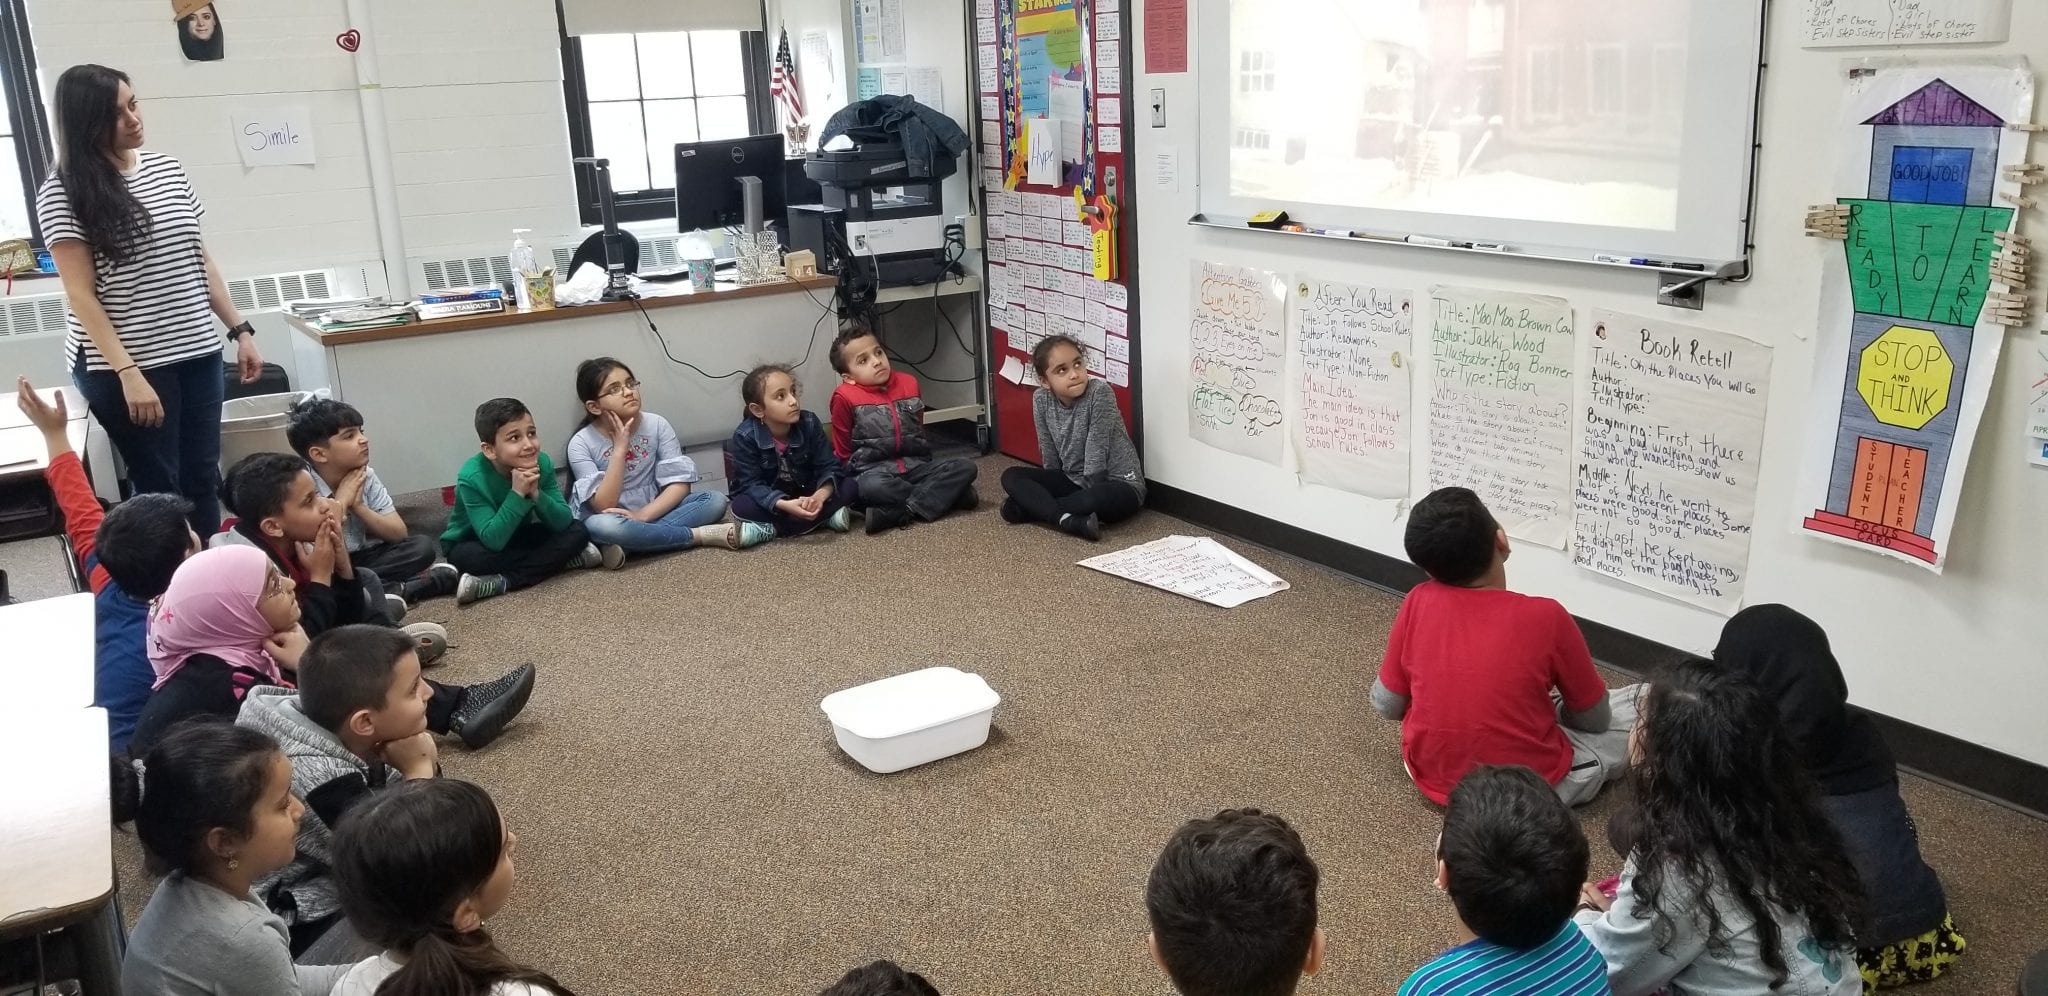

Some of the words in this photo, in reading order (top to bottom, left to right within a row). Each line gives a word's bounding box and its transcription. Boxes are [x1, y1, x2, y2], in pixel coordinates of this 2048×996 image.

[1812, 28, 1834, 40] Evil
[1894, 30, 1913, 39] Evil
[244, 121, 299, 151] Simile
[1032, 133, 1055, 173] Hype
[1894, 164, 1930, 181] GOOD
[1931, 165, 1965, 182] JOB!
[1850, 204, 1888, 312] READY
[1913, 225, 1933, 281] TO
[1950, 211, 1994, 325] LEARN
[1314, 283, 1346, 305] After
[1347, 287, 1369, 310] You
[1369, 288, 1394, 314] Read
[1432, 297, 1470, 323] Title:
[1472, 303, 1491, 325] Moo
[1493, 304, 1514, 328] Moo
[1518, 308, 1552, 333] Brown
[1299, 308, 1320, 326] Title:
[1371, 319, 1393, 333] School
[1300, 324, 1329, 340] Author:
[1432, 320, 1467, 343] Author:
[1469, 327, 1504, 349] Jakki
[1513, 331, 1545, 353] Wood
[1298, 339, 1346, 359] Illustrator:
[1432, 340, 1496, 366] Illustrator:
[1530, 355, 1573, 378] Bonner
[1640, 328, 1682, 361] Book
[1690, 338, 1733, 370] Retell
[1874, 340, 1942, 373] STOP
[1302, 372, 1325, 393] Main
[1326, 378, 1357, 399] Idea:
[1458, 363, 1492, 388] Type:
[1496, 370, 1538, 397] Fiction
[1592, 346, 1627, 369] Title:
[1630, 358, 1646, 375] Oh,
[1648, 363, 1666, 378] the
[1668, 365, 1701, 385] Places
[1704, 373, 1724, 390] You
[1745, 383, 1756, 395] Go
[1592, 367, 1628, 386] Author:
[1891, 374, 1910, 383] AND
[1300, 391, 1317, 408] The
[1323, 400, 1342, 412] main
[1346, 402, 1363, 415] idea
[1368, 407, 1375, 419] is
[1380, 405, 1400, 423] that
[1591, 392, 1613, 407] Text
[1618, 399, 1645, 415] Type:
[1592, 382, 1650, 402] Illustrator:
[1868, 378, 1939, 416] THINK
[1322, 414, 1329, 422] is
[1335, 415, 1353, 427] good
[1357, 419, 1365, 431] in
[1371, 421, 1395, 435] class
[1468, 416, 1477, 425] the
[1587, 406, 1652, 438] Beginning:
[1657, 426, 1693, 452] First,
[1699, 434, 1744, 461] there
[1582, 449, 1598, 460] the
[1607, 456, 1643, 469] world.
[1585, 426, 1607, 439] was
[1615, 434, 1623, 442] a
[1652, 442, 1694, 469] walking
[1699, 456, 1720, 469] and
[1578, 463, 1617, 484] Middle:
[1659, 481, 1673, 502] he
[1680, 498, 1712, 513] went
[1715, 507, 1730, 521] to
[1694, 466, 1721, 480] show
[1725, 475, 1736, 486] us
[1861, 441, 1877, 515] STUDENT
[1896, 448, 1912, 528] TEACHER
[1574, 501, 1597, 514] were
[1602, 507, 1619, 518] not
[1650, 523, 1686, 539] good.
[1579, 479, 1583, 488] a
[1608, 485, 1619, 498] of
[1627, 493, 1680, 515] different
[1722, 519, 1750, 534] Some
[1603, 498, 1627, 509] were
[1632, 506, 1663, 521] good.
[1694, 522, 1725, 539] places
[1853, 520, 1899, 539] FOCUS
[1857, 530, 1891, 548] CARD
[1575, 513, 1602, 536] End:
[1644, 537, 1662, 556] he
[1697, 560, 1739, 583] going,
[1576, 531, 1587, 542] he
[1640, 551, 1658, 566] the
[1663, 556, 1683, 572] bad
[1686, 569, 1718, 584] places
[1574, 541, 1596, 555] stop
[1606, 549, 1622, 564] him
[1631, 559, 1656, 576] from
[1661, 571, 1701, 595] finding
[1597, 560, 1626, 577] places.
